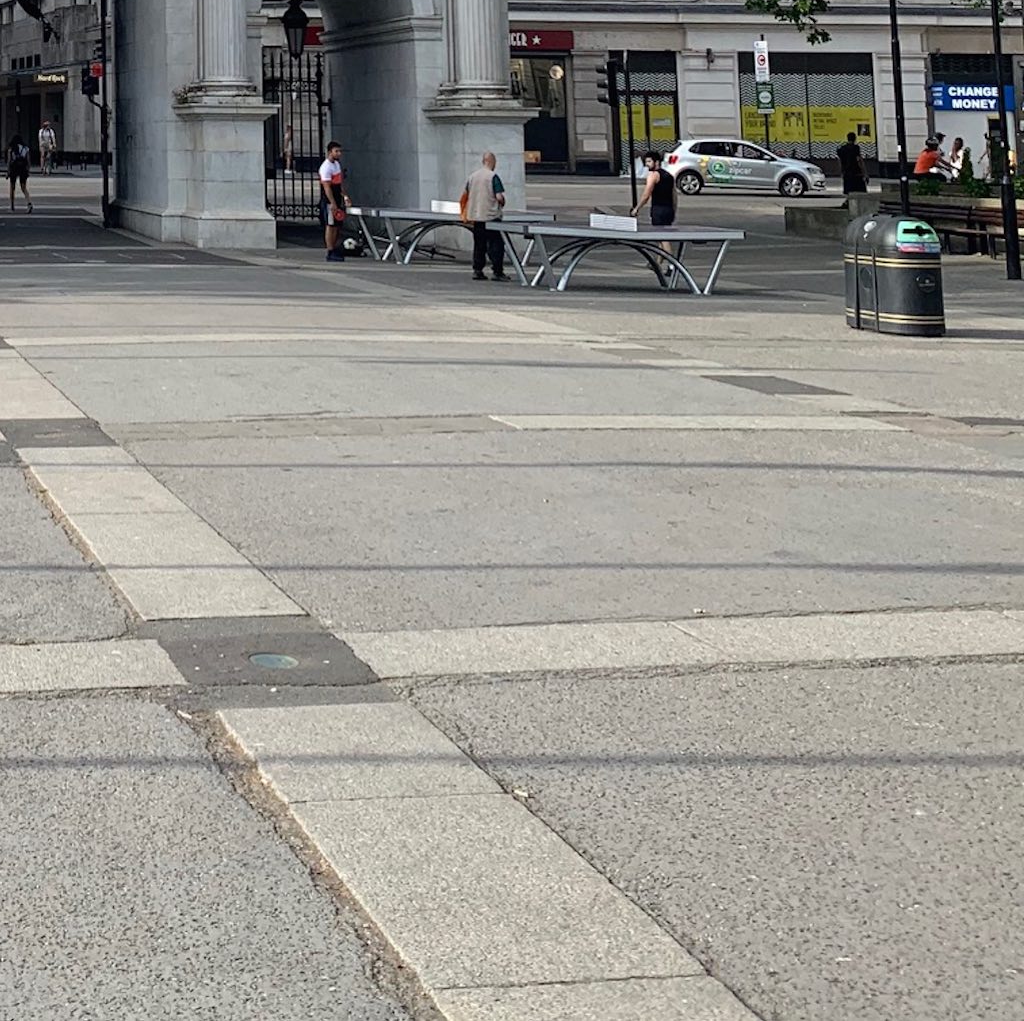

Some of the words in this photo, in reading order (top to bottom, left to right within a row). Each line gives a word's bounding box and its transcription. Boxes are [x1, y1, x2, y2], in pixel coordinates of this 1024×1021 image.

[508, 32, 528, 47] GER
[947, 86, 999, 97] CHANGE
[951, 99, 996, 109] MONEY
[728, 167, 753, 176] zipcar
